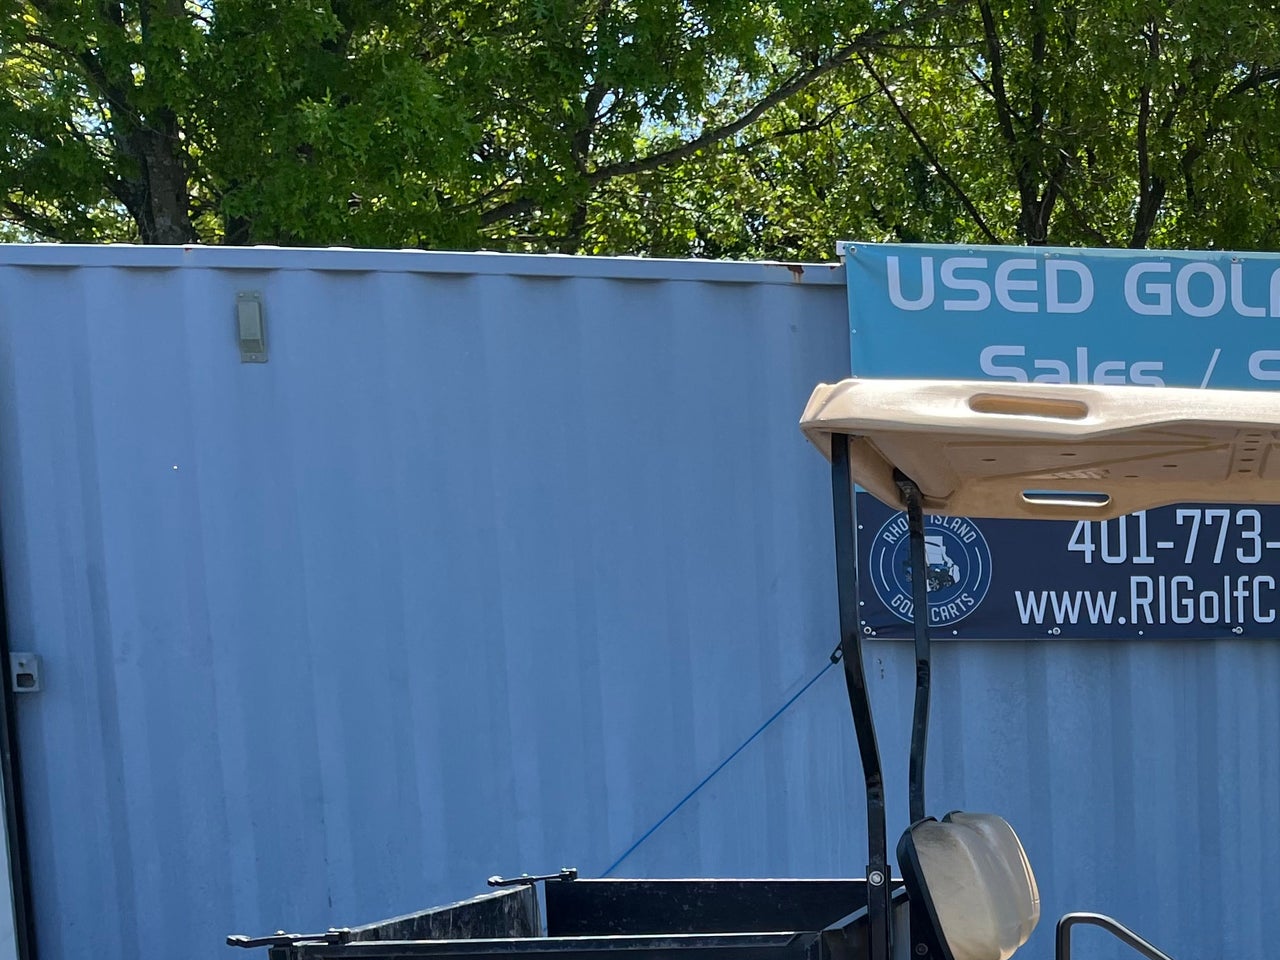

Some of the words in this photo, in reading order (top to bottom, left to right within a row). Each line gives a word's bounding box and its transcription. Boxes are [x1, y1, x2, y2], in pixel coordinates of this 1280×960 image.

[886, 256, 1094, 313] USED
[980, 345, 1165, 388] Sales
[883, 514, 910, 544] RHO
[930, 514, 977, 544] ISLAND
[891, 594, 915, 618] GOL
[931, 593, 975, 622] CARTS
